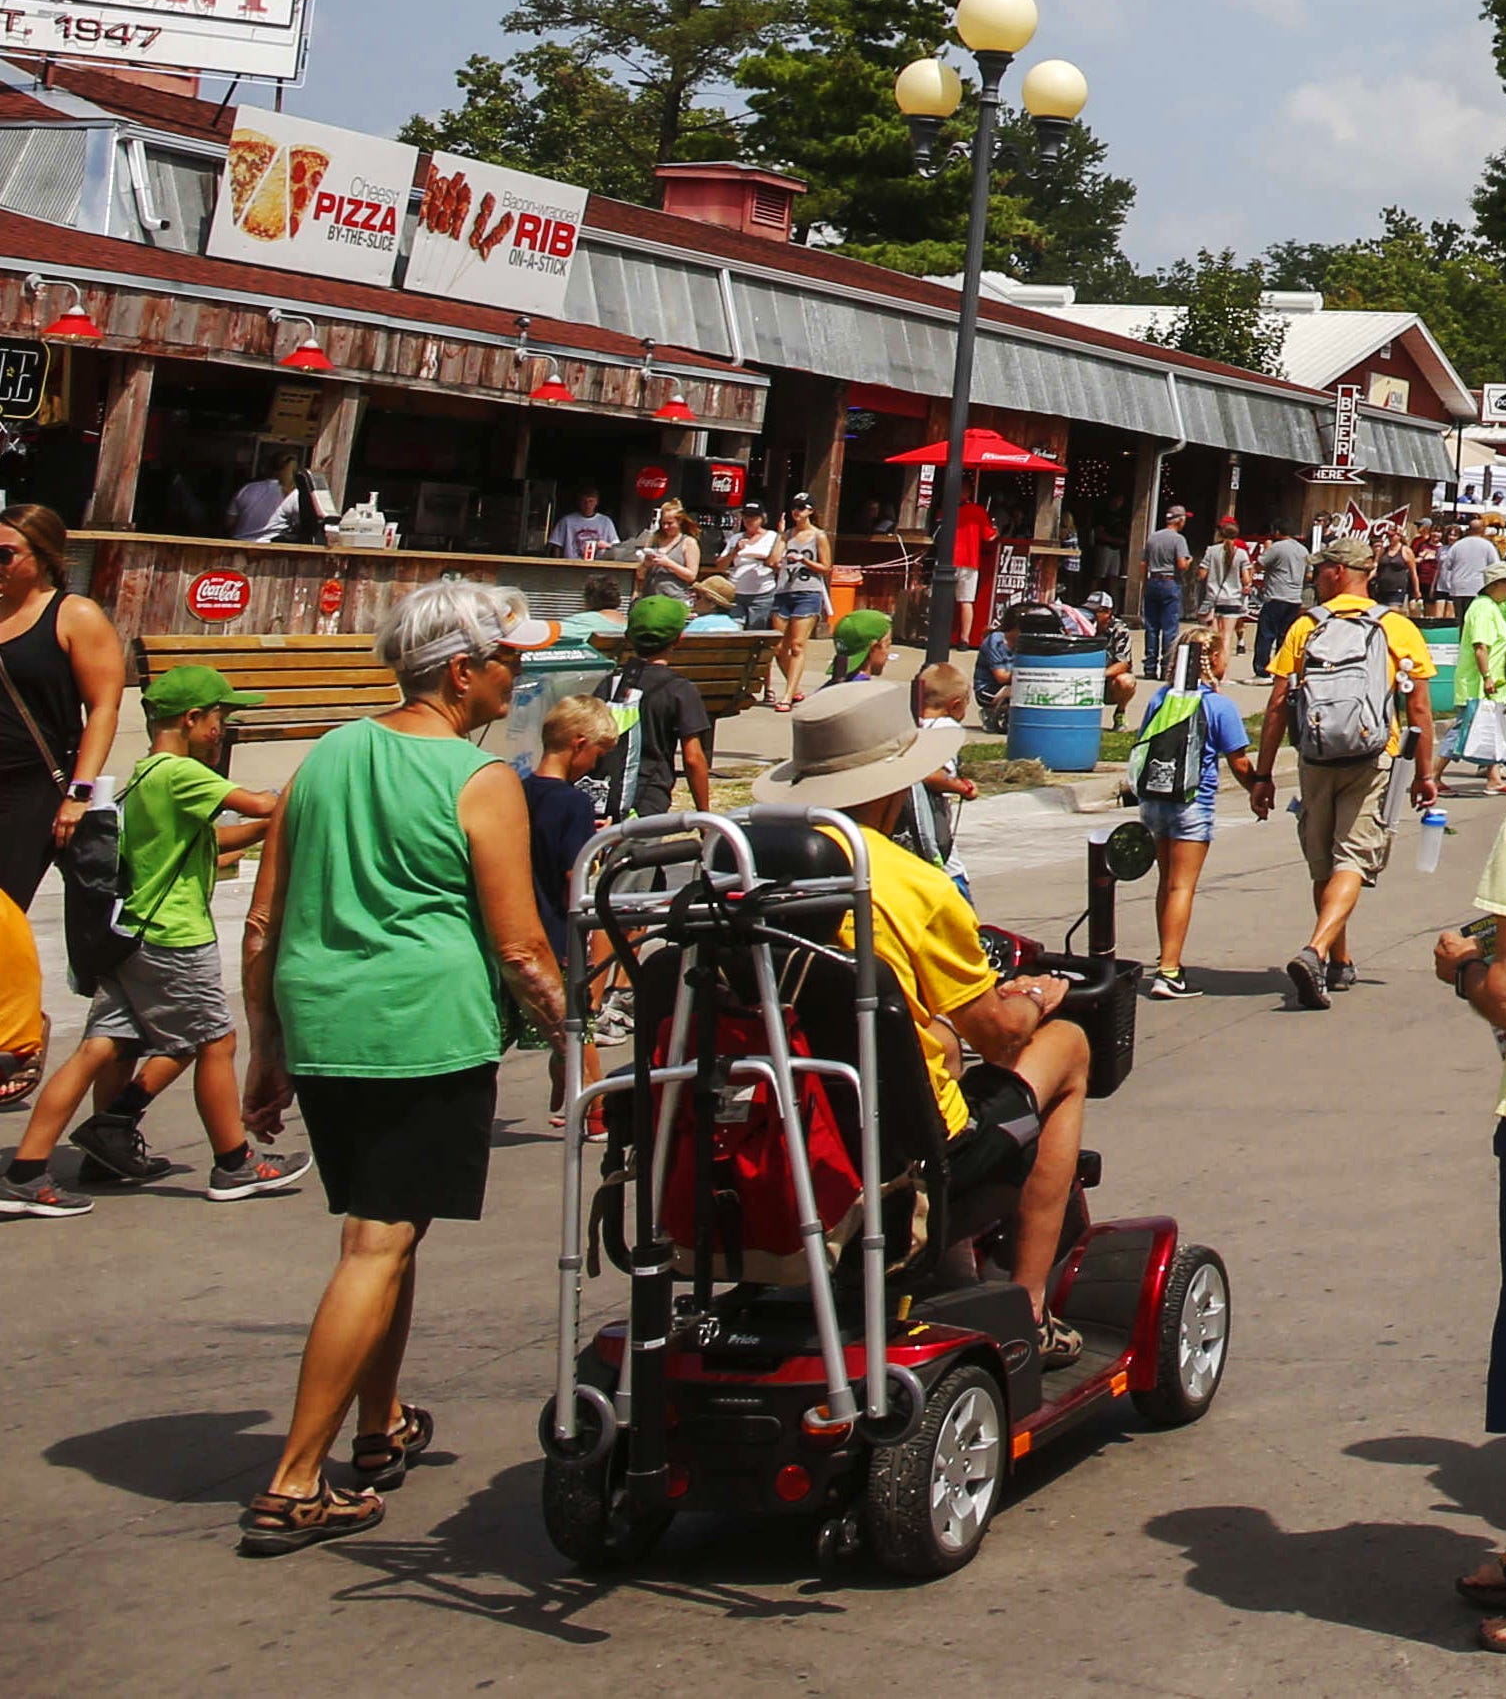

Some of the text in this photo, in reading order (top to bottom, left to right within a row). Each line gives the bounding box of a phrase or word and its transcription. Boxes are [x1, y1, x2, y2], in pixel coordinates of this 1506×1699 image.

[54, 14, 163, 49] 1947
[350, 176, 401, 207] Cheesy
[313, 191, 398, 236] PIZZA
[502, 191, 581, 226] Bacon-wrapped
[327, 225, 396, 253] BY-THE-SLICE
[513, 212, 577, 259] RIB
[508, 249, 568, 277] ON-A-STICK
[1338, 397, 1352, 455] BEER
[1312, 469, 1346, 480] HERE
[196, 579, 244, 602] Coca-Cola
